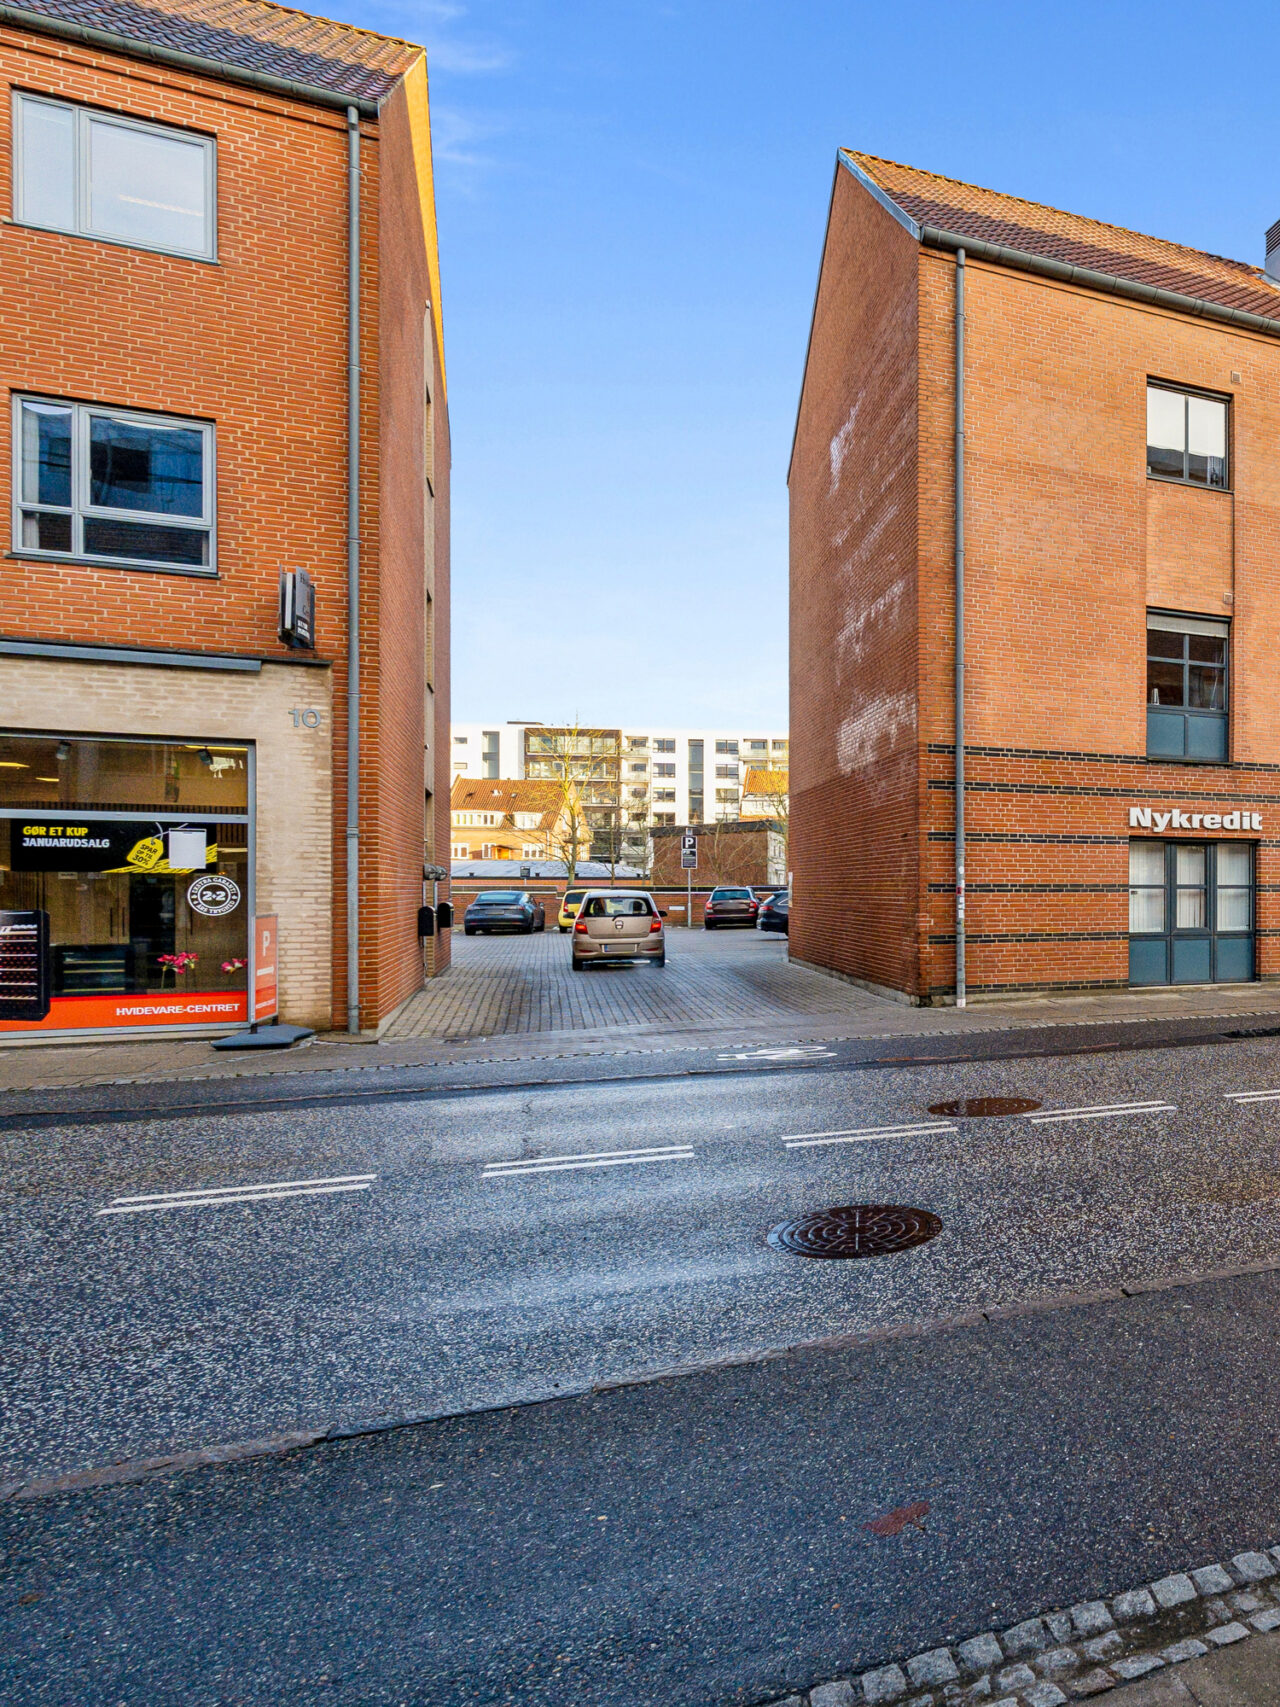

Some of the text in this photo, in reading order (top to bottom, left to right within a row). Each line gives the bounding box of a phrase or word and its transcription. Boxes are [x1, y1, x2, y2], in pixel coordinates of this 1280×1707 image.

[288, 708, 321, 728] 10
[1129, 807, 1263, 833] Nykredit
[23, 826, 88, 836] GØR ET KUP
[22, 837, 110, 848] JANUARUDSALG
[685, 837, 694, 849] P
[140, 844, 158, 855] SPAR
[132, 855, 150, 866] 30%
[262, 930, 271, 957] P
[116, 1003, 240, 1016] HVIDEVARE-CENTRET
